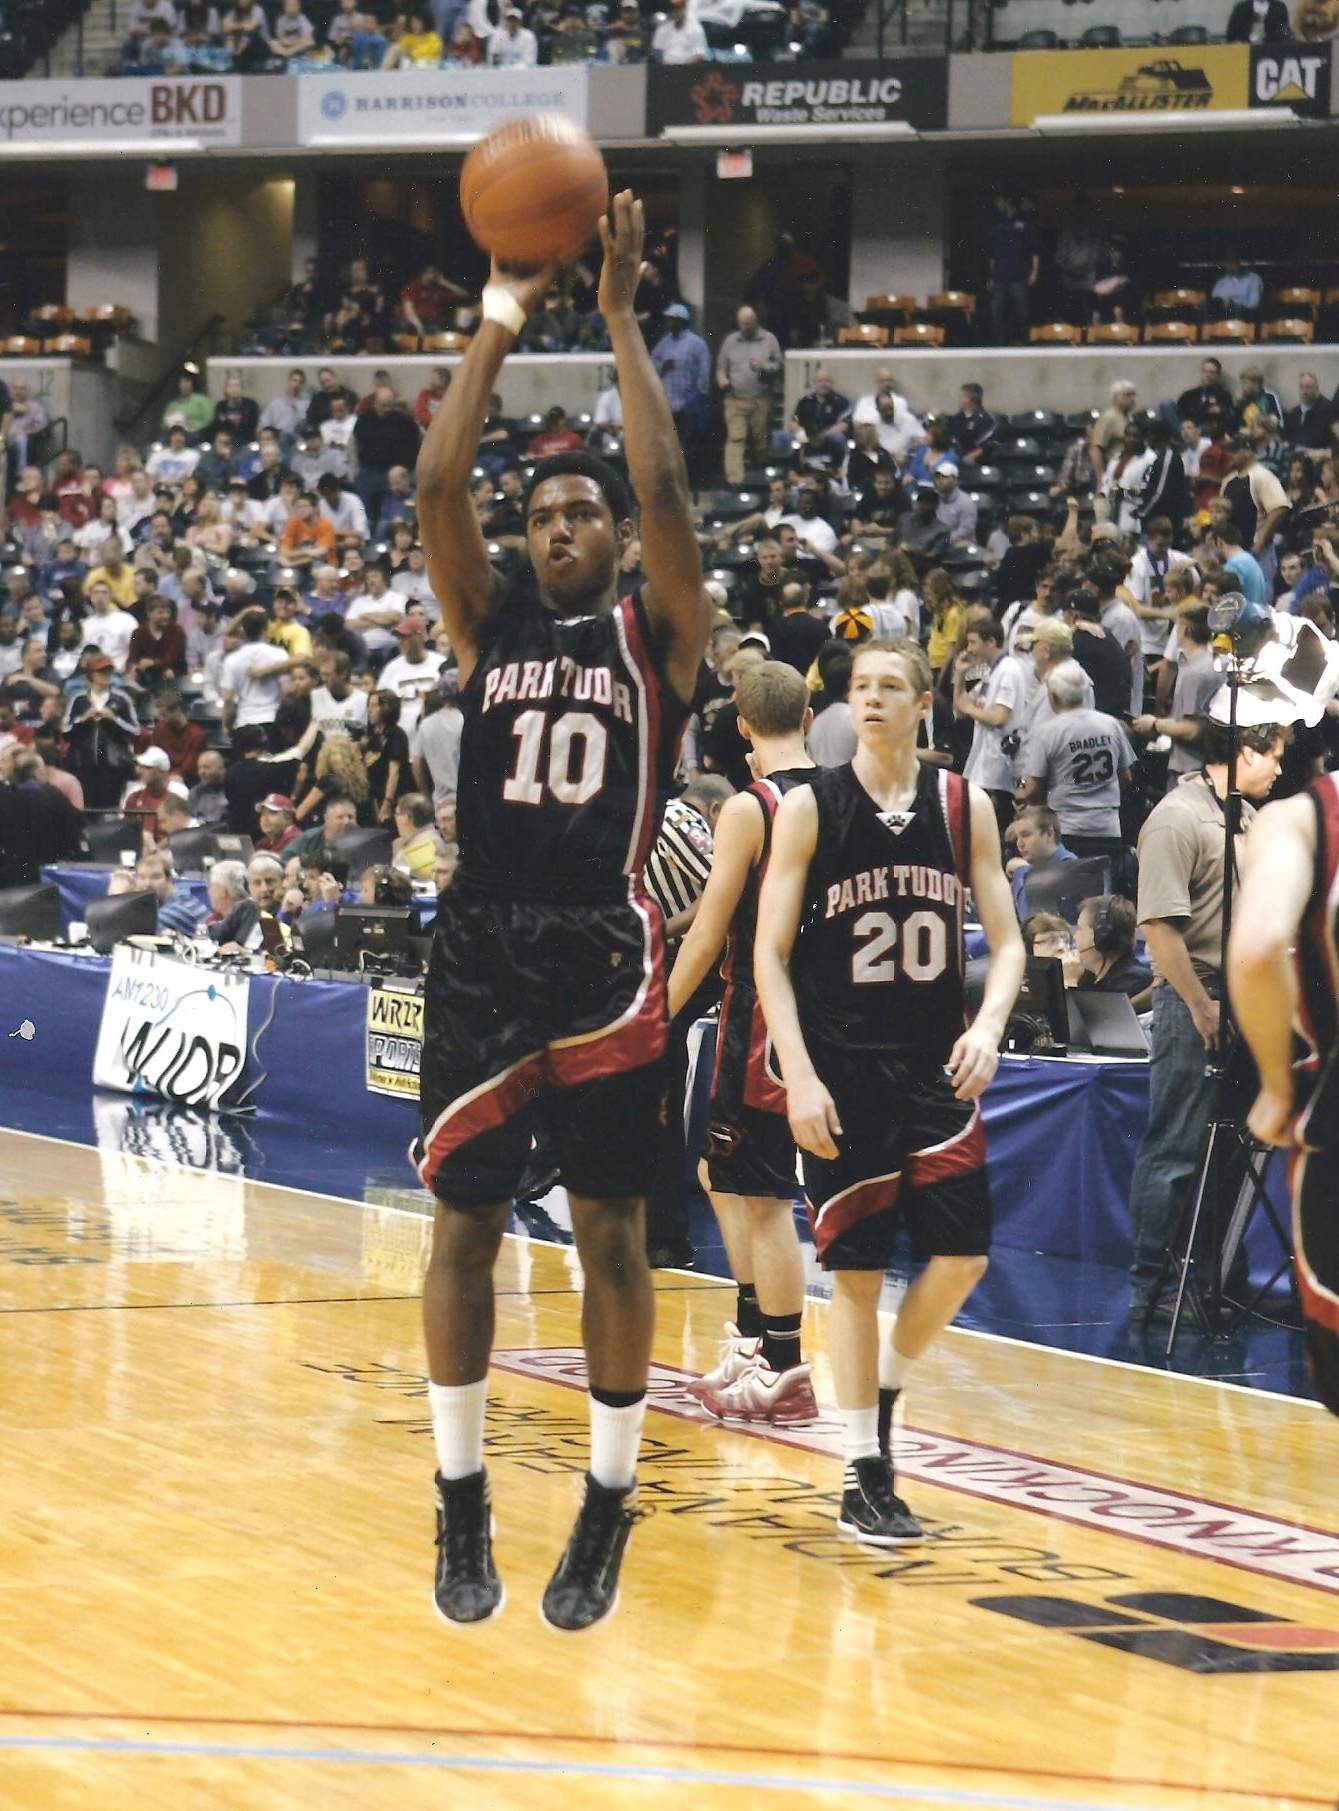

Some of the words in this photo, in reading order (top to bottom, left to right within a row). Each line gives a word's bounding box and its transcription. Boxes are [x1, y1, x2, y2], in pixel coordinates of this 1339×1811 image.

[741, 78, 902, 106] REPUBLIC
[1256, 58, 1322, 100] CAT
[151, 84, 227, 124] BKD
[356, 95, 468, 111] HARRISON
[755, 106, 808, 122] Waste
[812, 105, 886, 121] Services
[502, 708, 608, 805] 10
[1068, 734, 1112, 753] BRADLEY
[1071, 749, 1114, 785] 23
[825, 866, 890, 919] PARK
[892, 864, 972, 914] TUDO
[852, 910, 947, 984] 20
